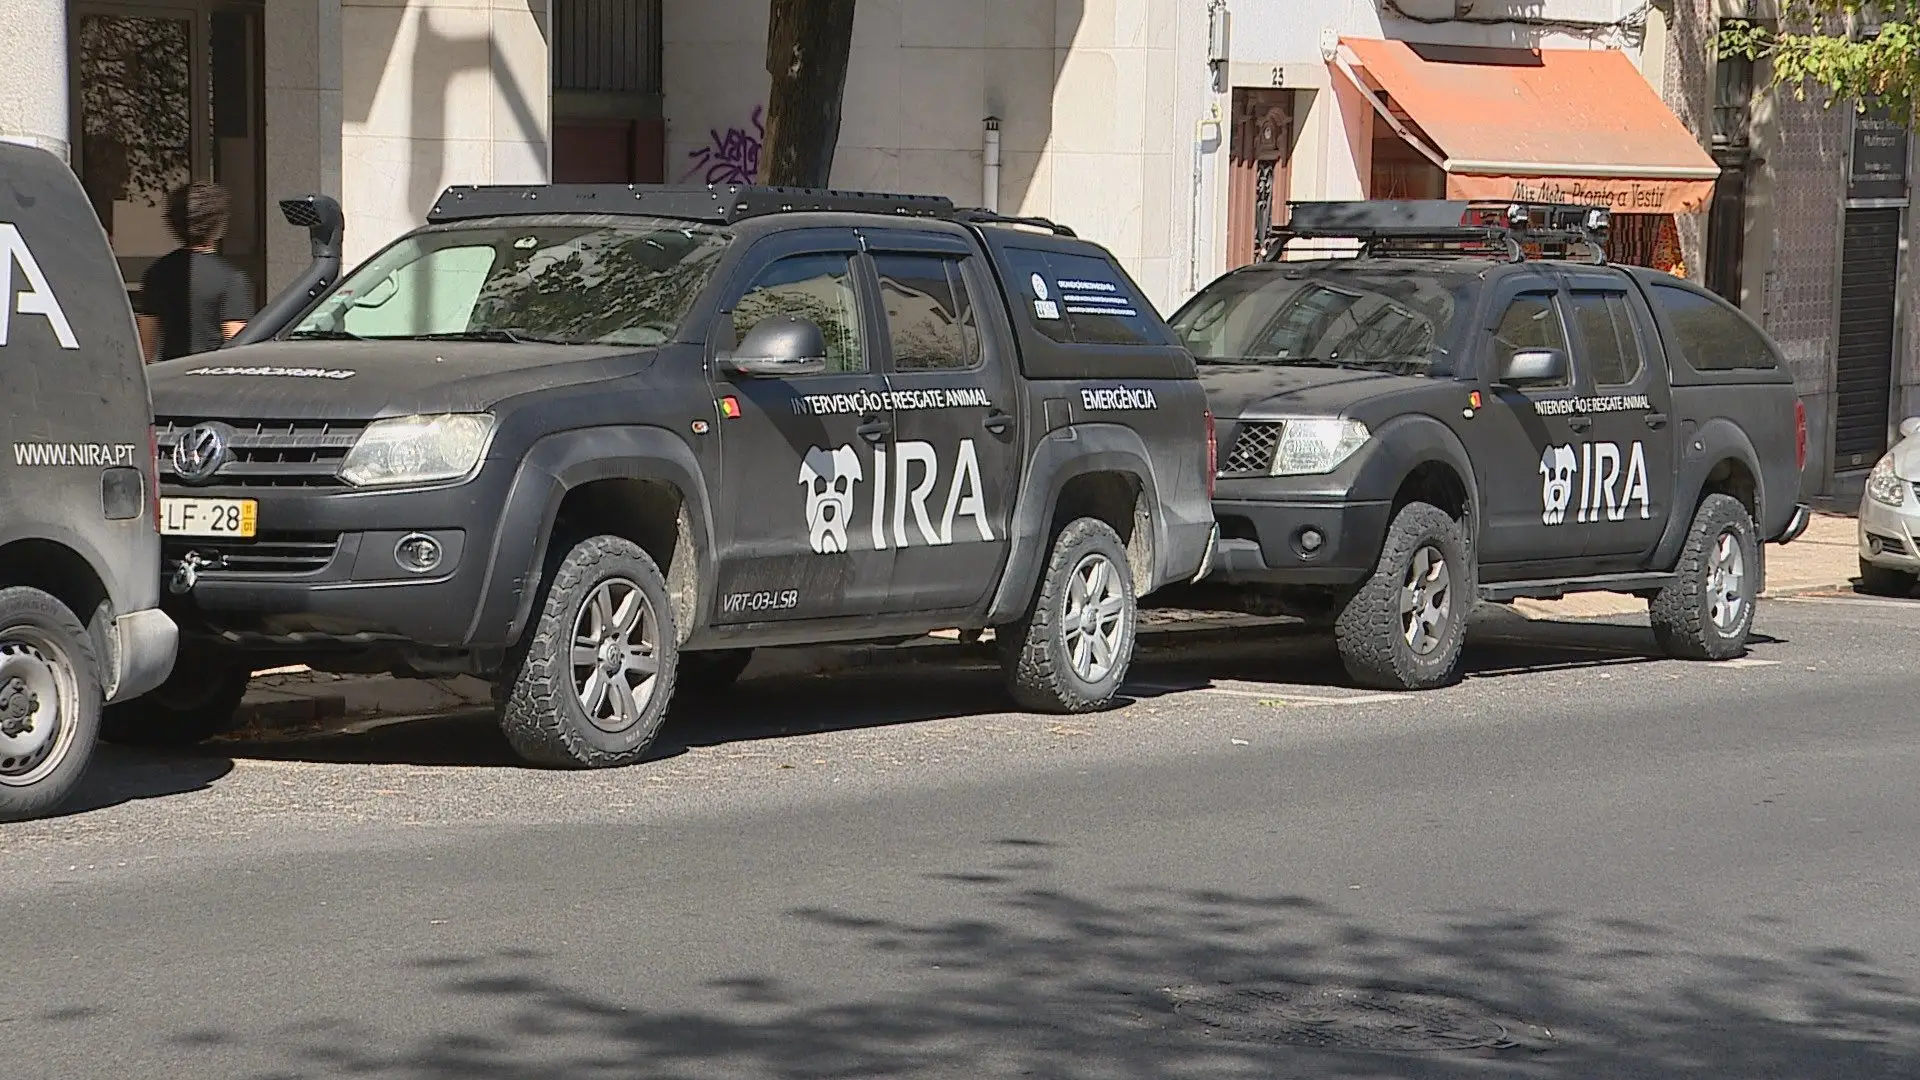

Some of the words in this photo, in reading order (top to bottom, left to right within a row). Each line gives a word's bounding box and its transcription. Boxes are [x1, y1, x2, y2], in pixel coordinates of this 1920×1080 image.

[1512, 181, 1535, 201] Mix
[1572, 182, 1614, 206] Pronto
[1617, 191, 1628, 207] a
[1631, 183, 1664, 208] Vestir
[0, 223, 80, 349] A
[790, 389, 880, 416] INTERVENÇÃO
[881, 392, 893, 410] E
[893, 389, 944, 409] RESGATE
[944, 388, 990, 406] ANIMAL
[1081, 384, 1157, 410] EMERGÊNCIA
[1592, 396, 1622, 412] RESGATE
[1623, 394, 1651, 410] ANIMAL
[13, 442, 136, 466] WWW.NIRA.PT
[872, 438, 995, 550] IRA
[1577, 441, 1650, 522] IRA
[723, 589, 798, 612] VRT-03-LSB
